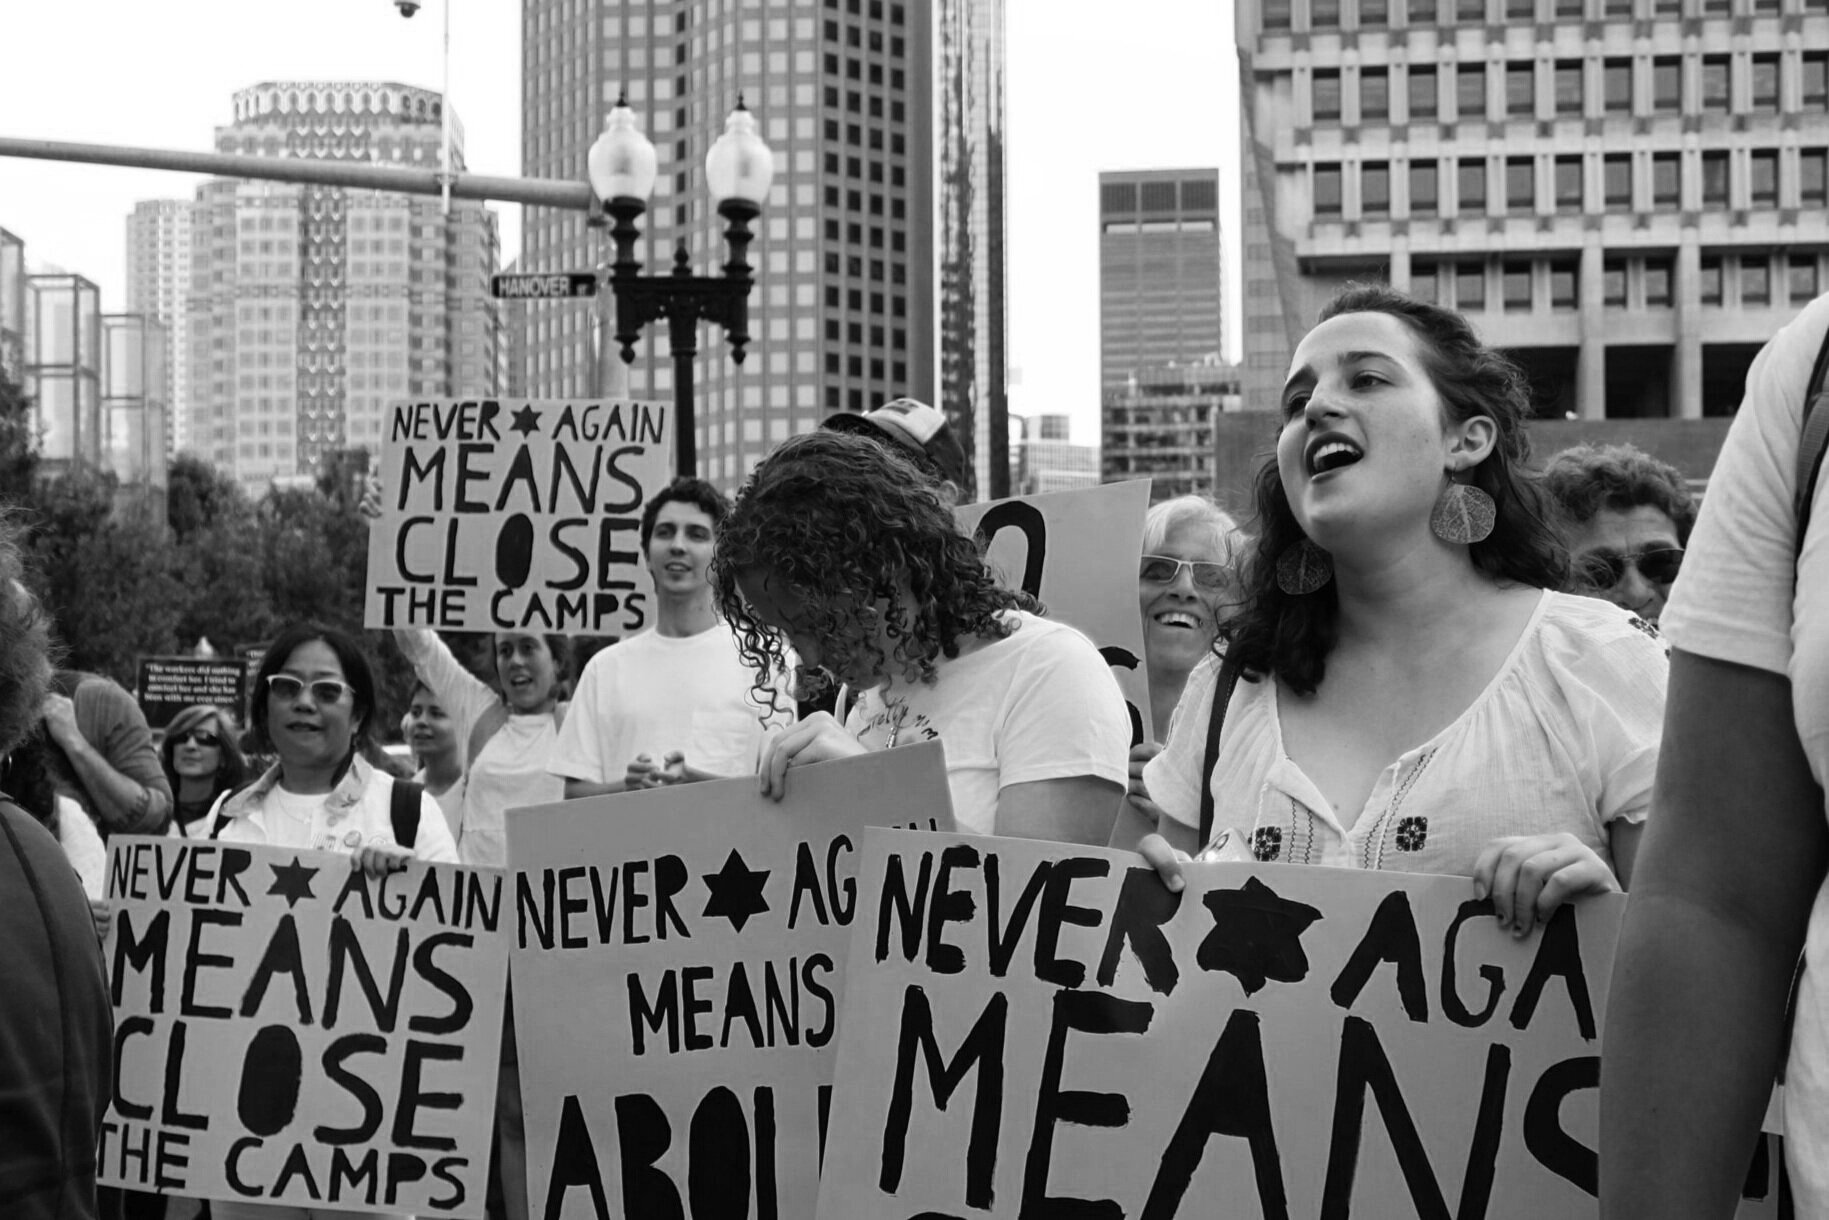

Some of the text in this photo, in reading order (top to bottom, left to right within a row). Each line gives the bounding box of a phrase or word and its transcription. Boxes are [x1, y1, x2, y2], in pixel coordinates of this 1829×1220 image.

[499, 276, 569, 297] HANOVER
[392, 400, 665, 444] NEVER AGAIN
[398, 442, 646, 514] MEANS
[396, 512, 641, 591] CLOSE
[377, 586, 646, 631] THE CAMPS
[211, 665, 241, 677] nothing
[109, 844, 502, 932] NEVER AGAIN
[516, 854, 692, 950] NEVER
[111, 909, 473, 1035] MEANS
[875, 844, 1597, 1043] NEVER AGA
[626, 953, 836, 1056] MEANS
[112, 1015, 464, 1151] CLOSE
[97, 1122, 469, 1210] THE CAMPS
